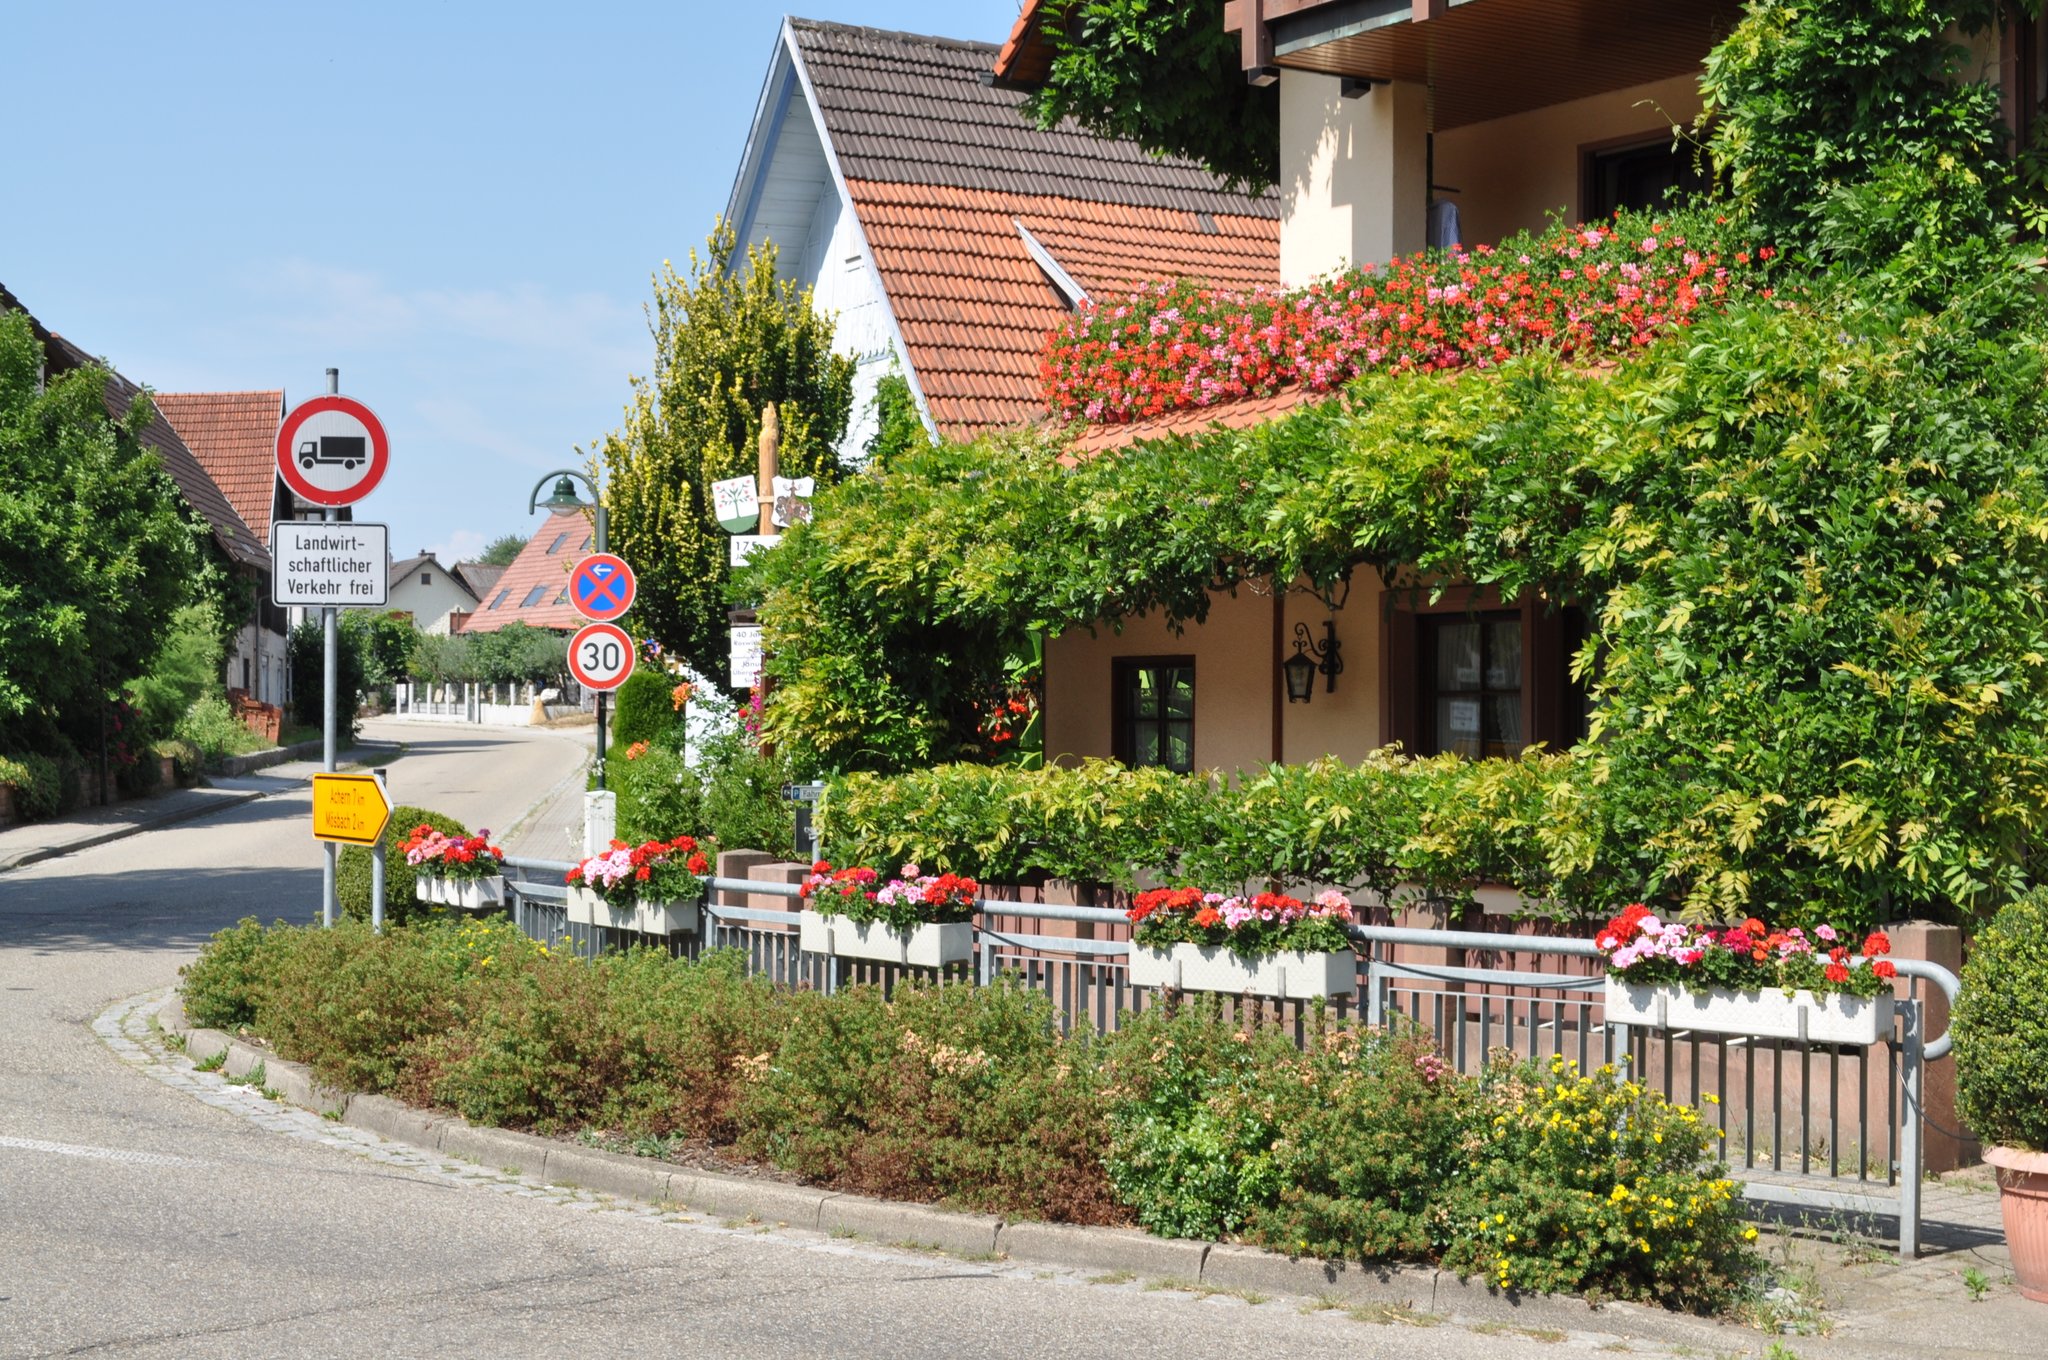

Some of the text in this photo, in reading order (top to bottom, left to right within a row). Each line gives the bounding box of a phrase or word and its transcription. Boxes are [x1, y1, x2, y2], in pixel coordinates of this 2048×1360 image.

[295, 534, 365, 551] Landwirt-
[288, 557, 372, 573] schaftlicher
[287, 578, 373, 595] Verkehr frei
[583, 642, 619, 671] 30
